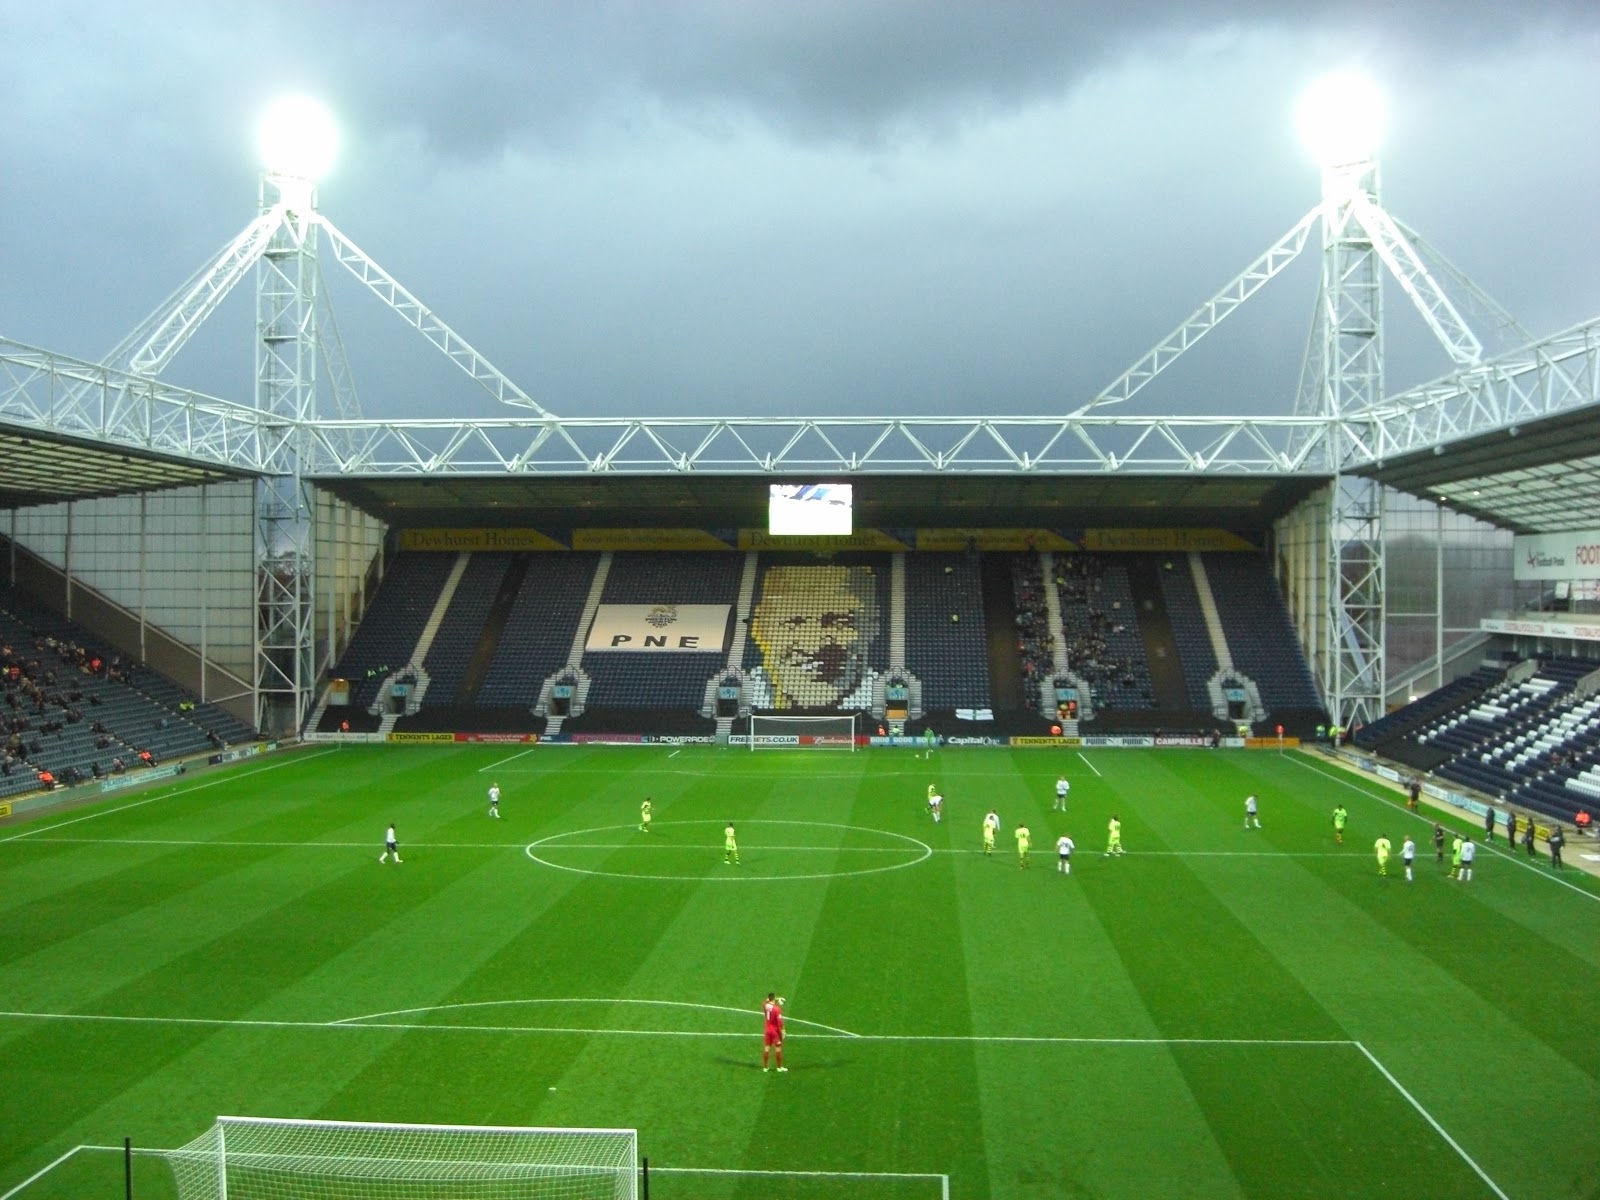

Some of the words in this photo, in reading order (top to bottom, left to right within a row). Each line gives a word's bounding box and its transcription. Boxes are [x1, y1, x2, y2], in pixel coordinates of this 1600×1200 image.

[413, 530, 480, 546] Dewhurst
[485, 530, 535, 546] Homes
[611, 634, 700, 648] PNE
[659, 735, 710, 743] POWERADE
[1057, 737, 1081, 745] LAGER
[1156, 737, 1203, 745] CAMPBELLS
